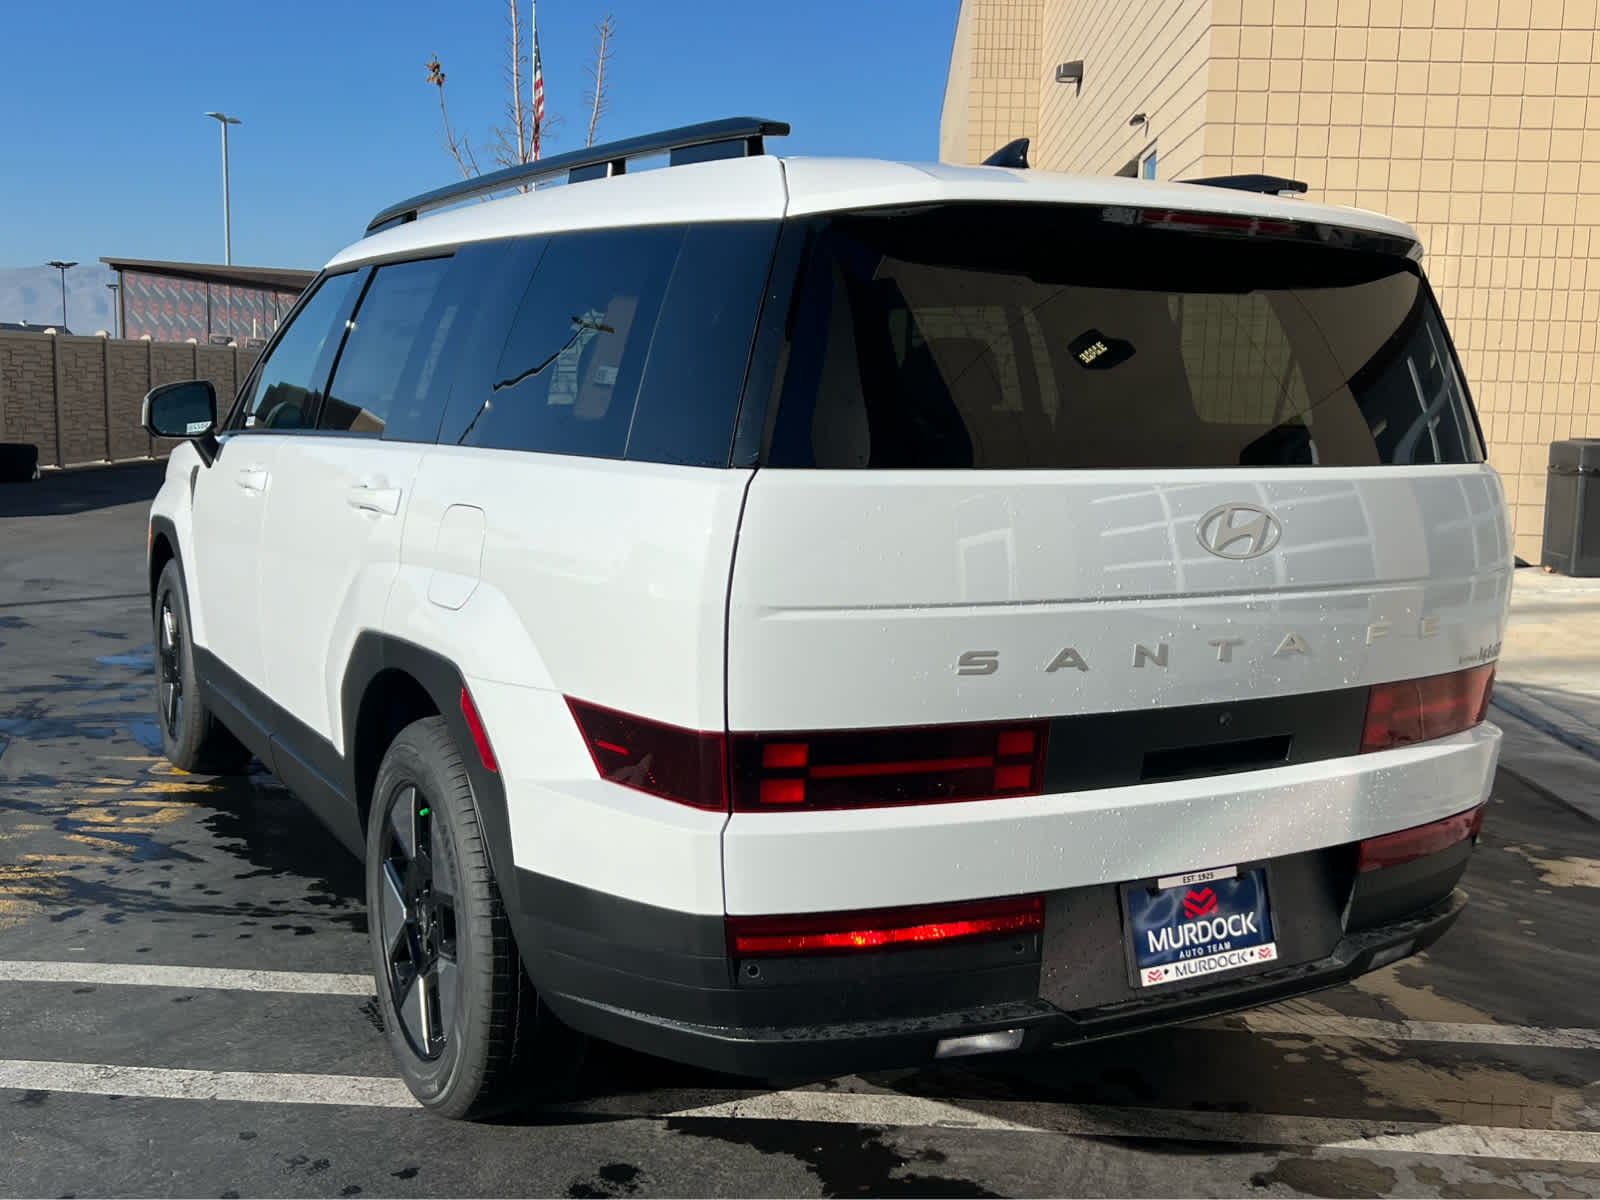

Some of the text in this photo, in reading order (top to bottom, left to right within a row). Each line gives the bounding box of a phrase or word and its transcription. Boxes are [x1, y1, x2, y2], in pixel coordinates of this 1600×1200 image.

[957, 616, 1442, 675] SANTA FE
[1147, 912, 1258, 953] MURDOCK
[1175, 952, 1248, 977] MURDOCK
[1179, 941, 1231, 960] AUTO TEAM
